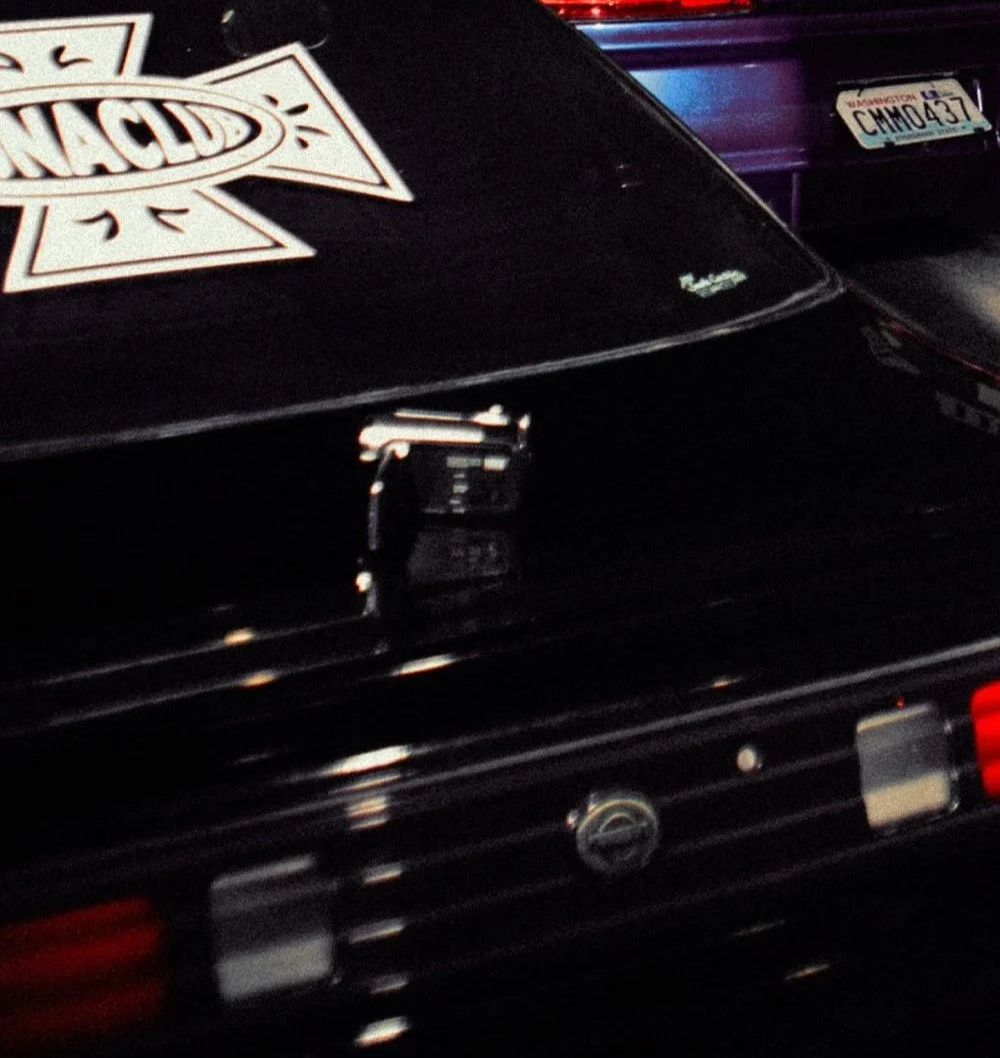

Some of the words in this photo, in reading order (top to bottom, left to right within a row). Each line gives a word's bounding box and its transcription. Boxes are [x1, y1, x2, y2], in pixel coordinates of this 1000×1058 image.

[845, 93, 917, 109] WASHINGTON
[852, 97, 972, 137] CMM0437
[0, 98, 250, 179] NACLUB
